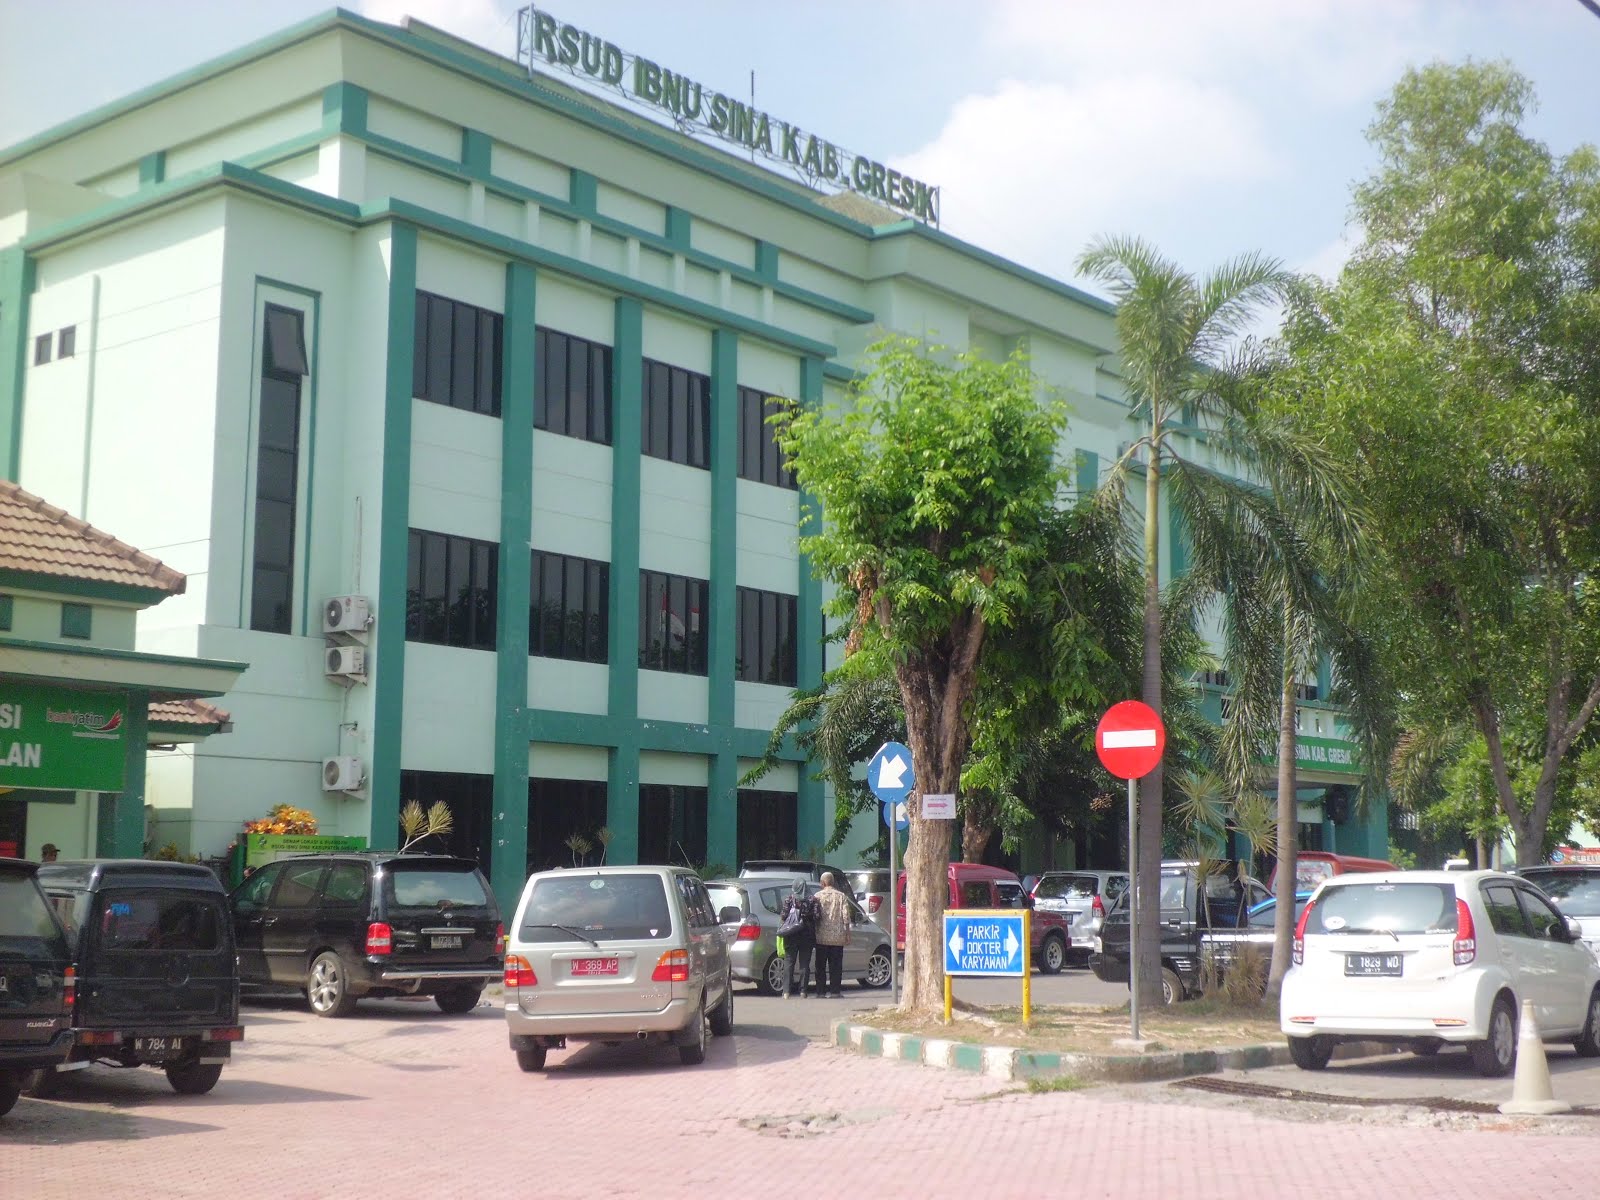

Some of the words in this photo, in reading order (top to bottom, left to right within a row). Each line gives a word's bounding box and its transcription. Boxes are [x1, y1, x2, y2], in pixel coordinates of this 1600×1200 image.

[534, 10, 623, 85] RSUD
[634, 55, 701, 119] IBNU
[709, 92, 772, 153] SINA
[782, 121, 849, 186] KAB.
[853, 155, 937, 222] GRESIK
[0, 703, 21, 729] SI
[967, 924, 1000, 939] PARKIR
[967, 941, 1001, 955] DOKTER
[572, 960, 579, 970] W
[585, 960, 602, 970] 369
[606, 959, 618, 970] AP
[962, 955, 1007, 969] KARYAWAN
[1348, 956, 1354, 968] L
[1360, 956, 1381, 968] 1829
[135, 1038, 142, 1050] W
[148, 1038, 165, 1050] 784
